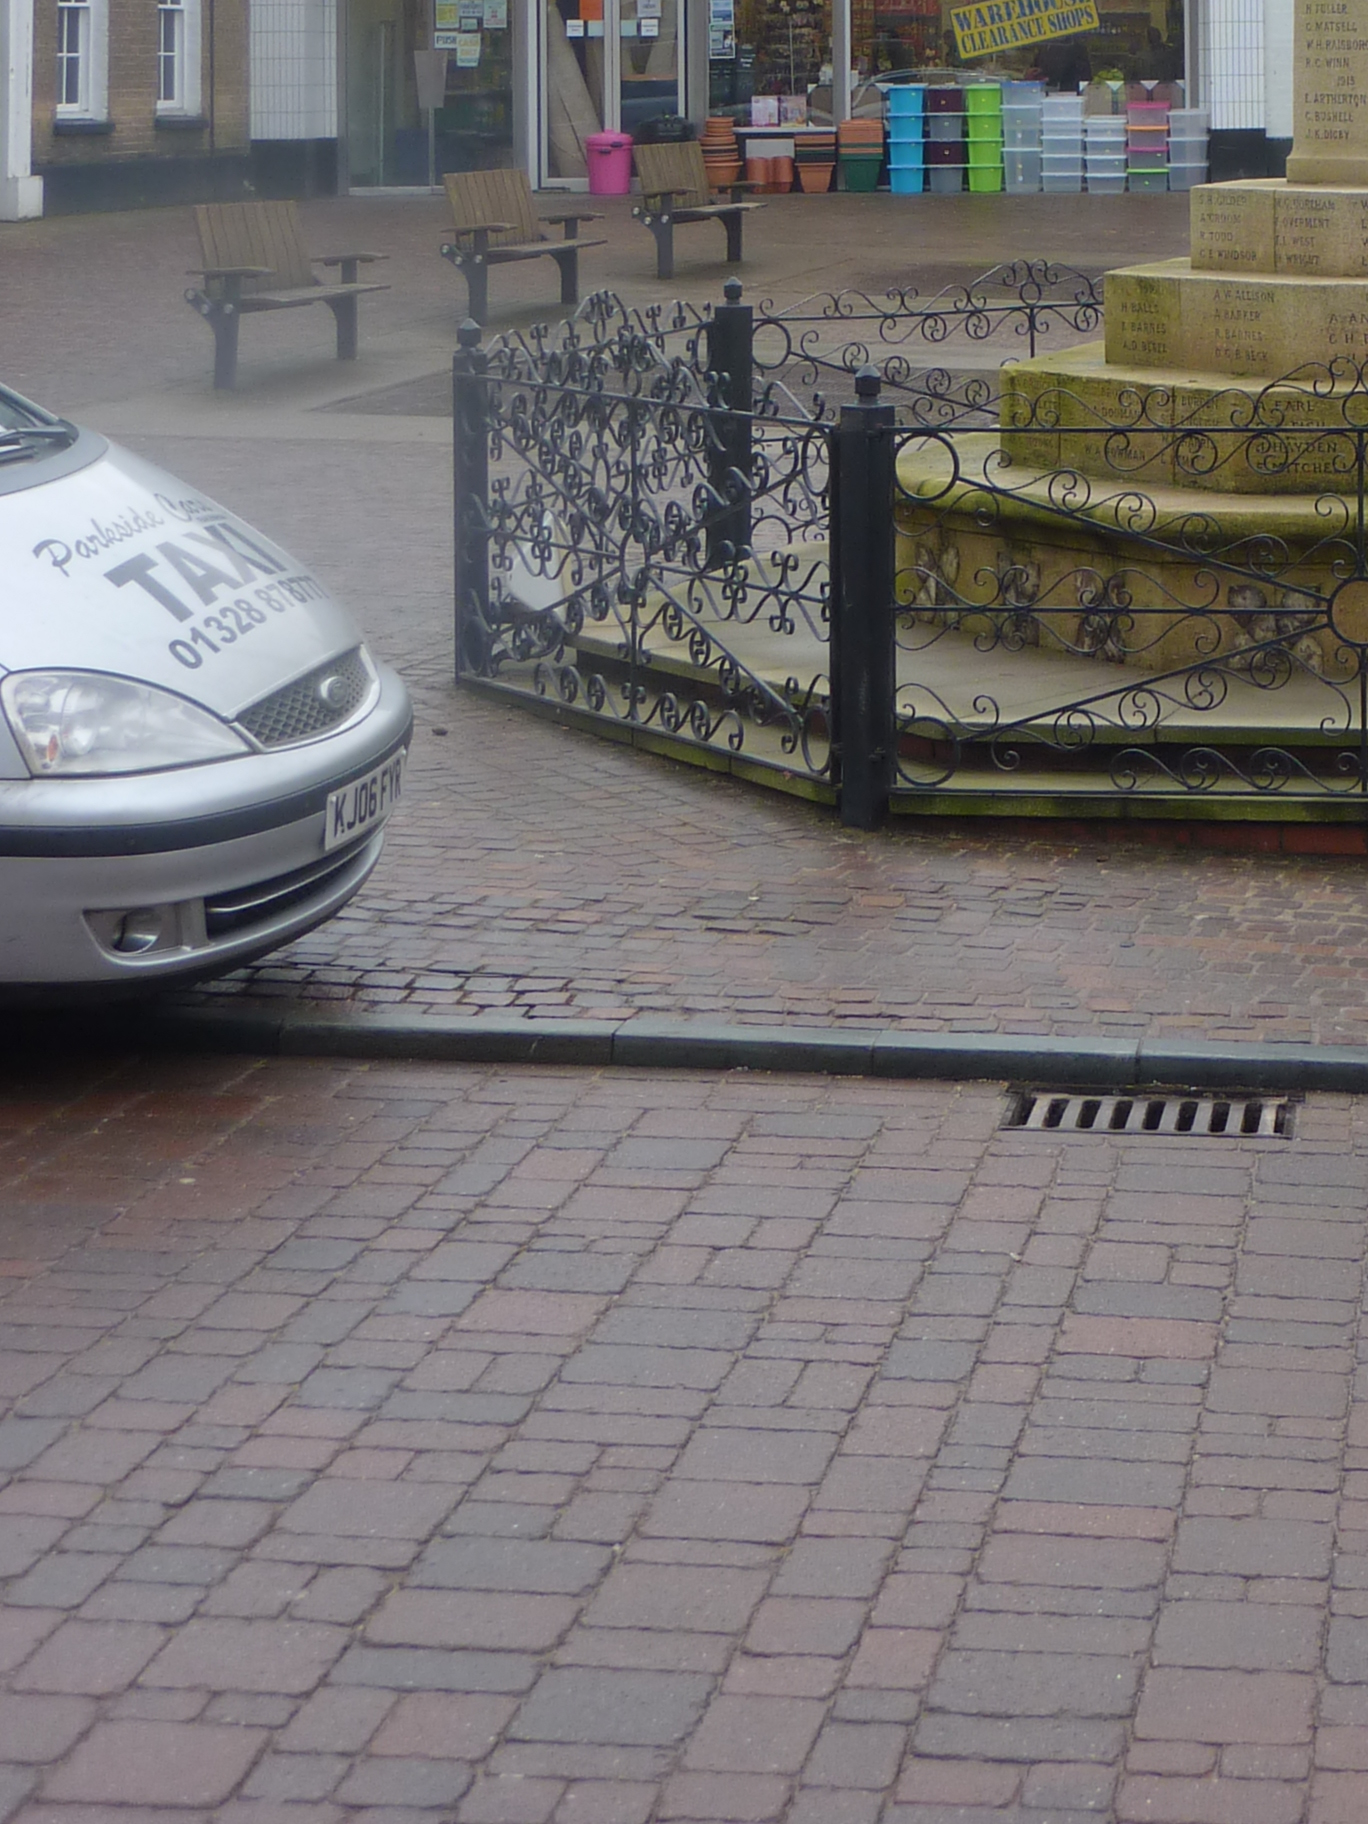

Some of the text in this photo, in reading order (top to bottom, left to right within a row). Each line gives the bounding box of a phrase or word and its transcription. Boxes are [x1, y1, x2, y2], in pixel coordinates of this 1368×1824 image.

[961, 5, 1094, 54] CLEARANCE SHOPS
[32, 506, 165, 578] Parkside
[103, 522, 288, 623] TAXI
[168, 598, 268, 670] 01328
[334, 776, 377, 838] KJ06
